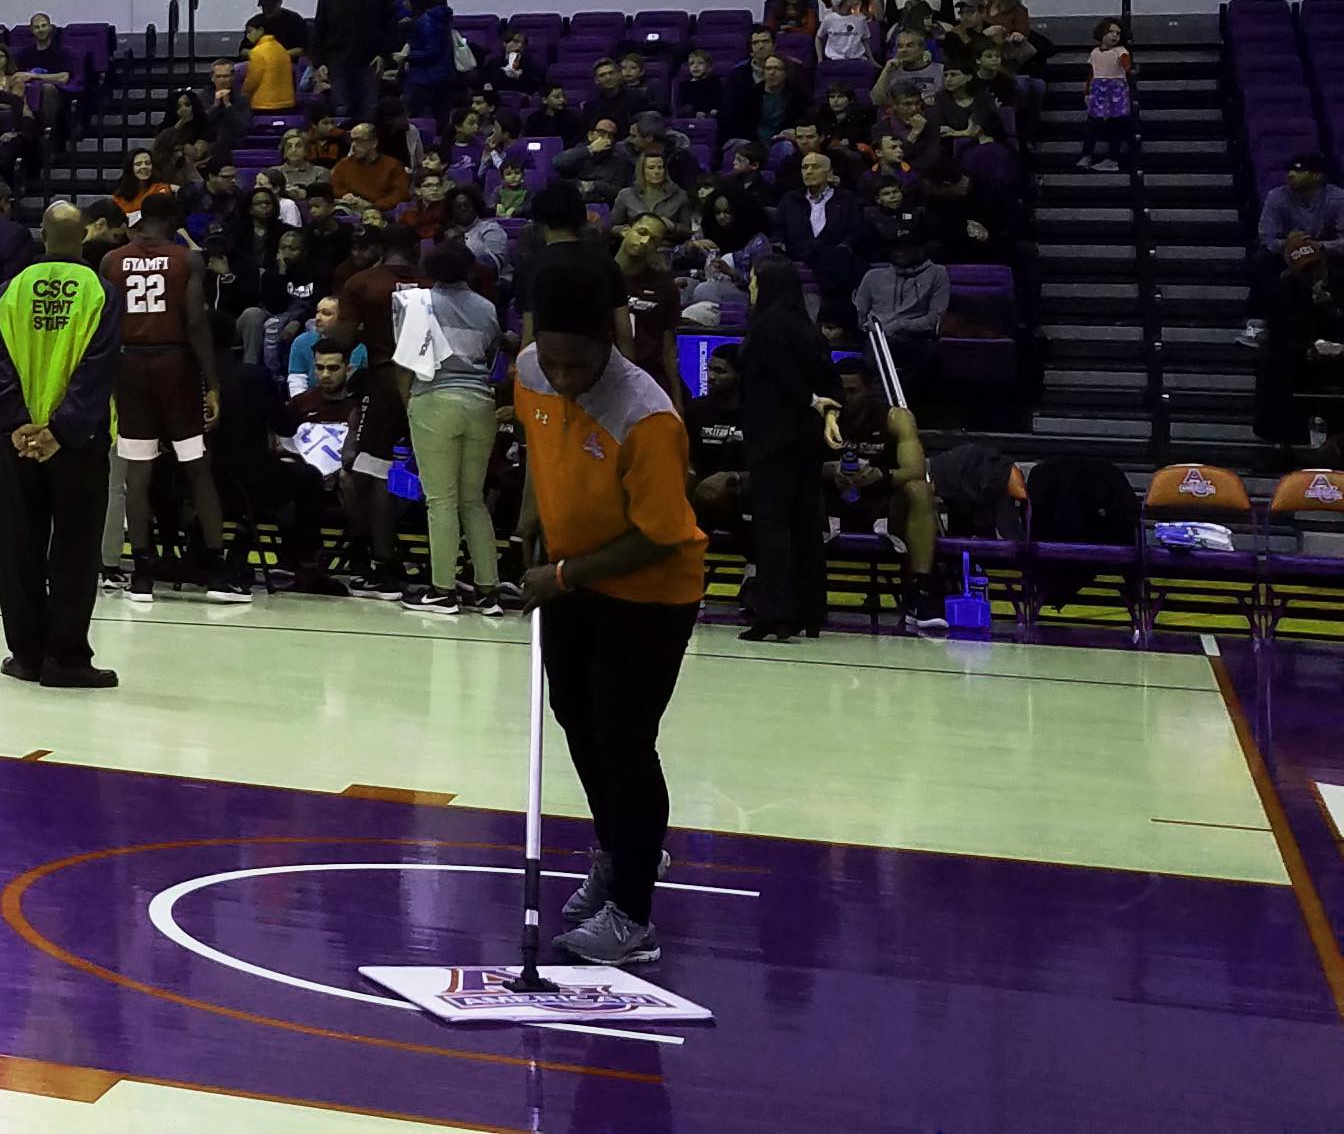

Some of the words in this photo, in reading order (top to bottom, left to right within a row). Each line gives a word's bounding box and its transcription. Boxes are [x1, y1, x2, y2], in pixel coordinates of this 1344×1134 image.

[122, 256, 169, 272] GYAMFI
[32, 279, 79, 299] CSC
[125, 273, 167, 314] 22
